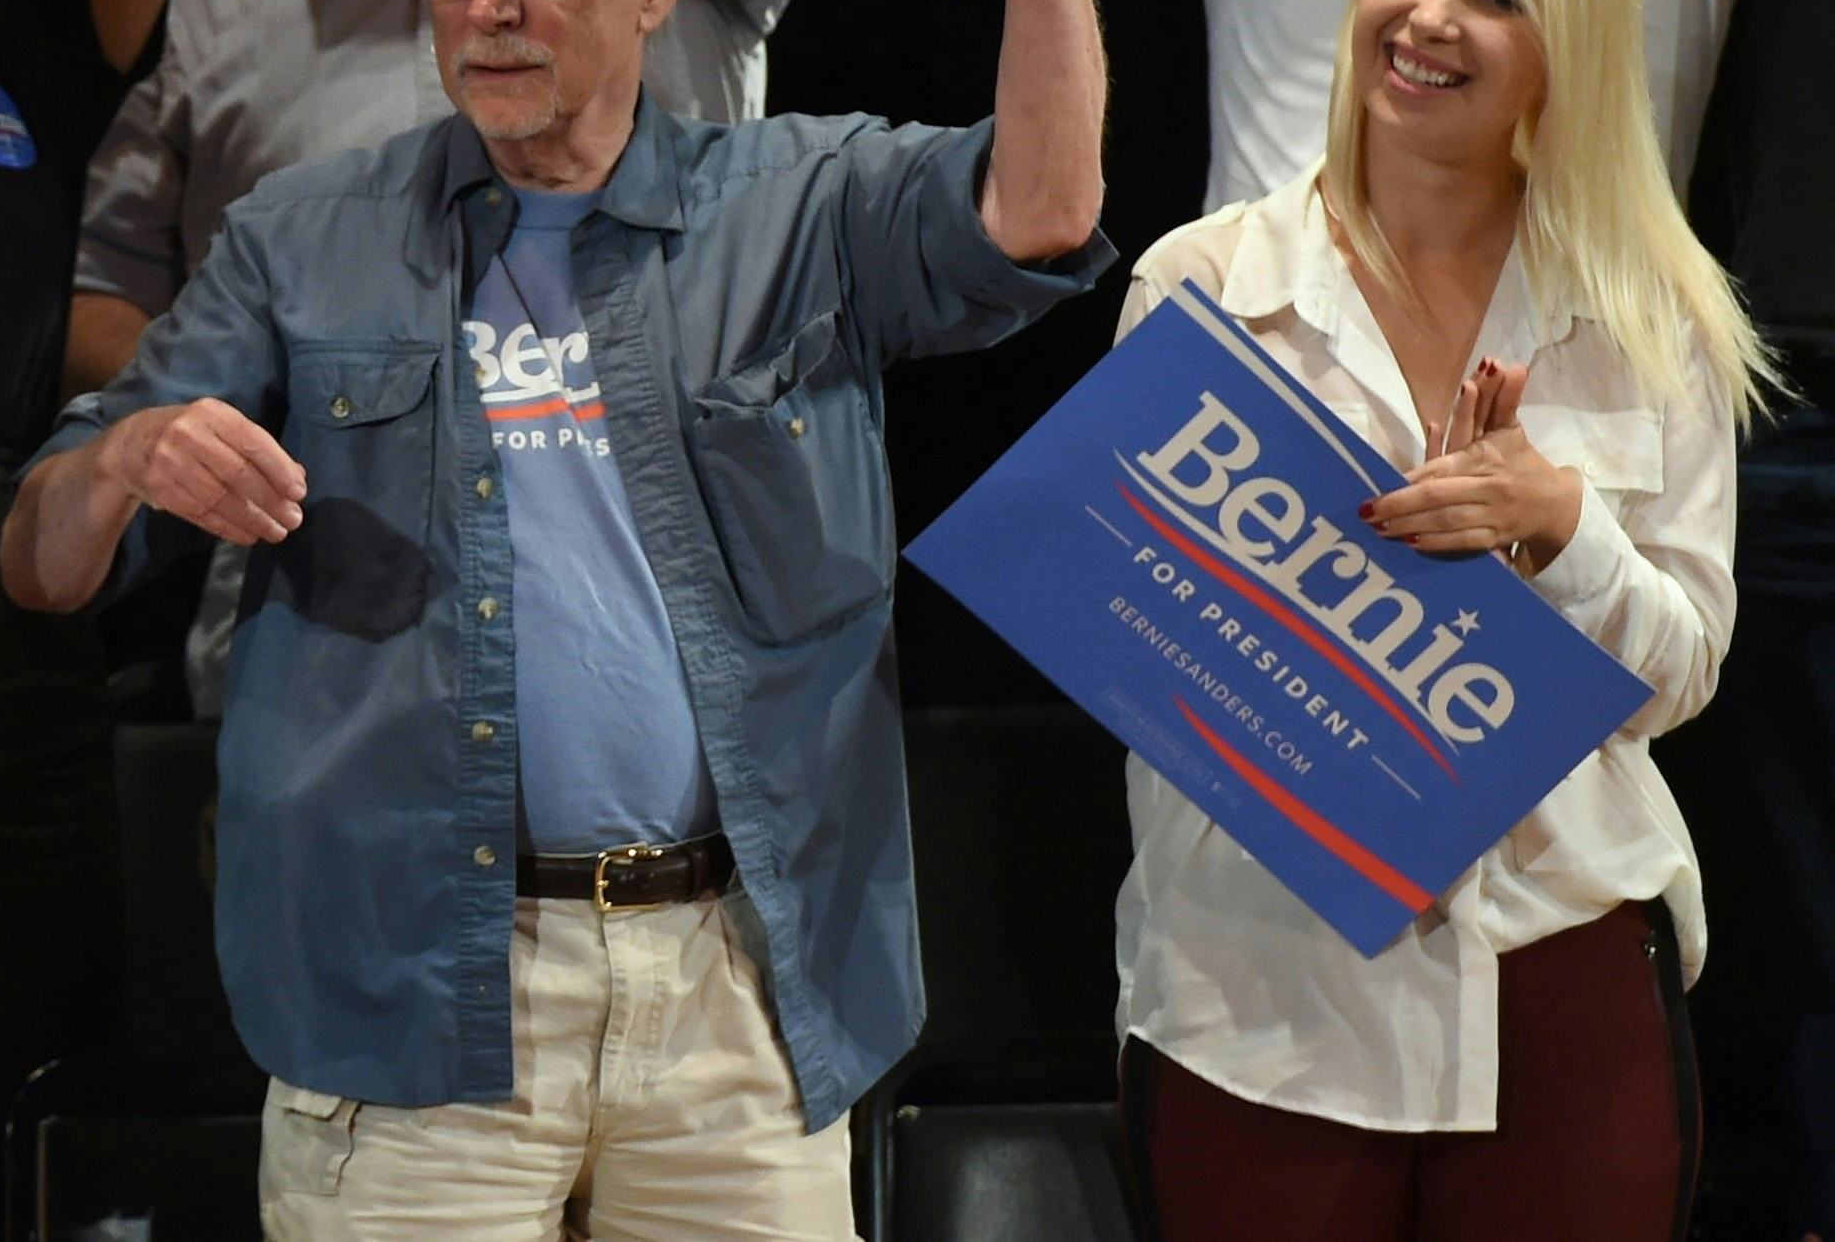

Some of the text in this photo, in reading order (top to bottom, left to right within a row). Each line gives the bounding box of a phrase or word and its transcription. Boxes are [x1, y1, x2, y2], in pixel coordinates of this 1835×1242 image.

[462, 321, 602, 403] Ber
[491, 430, 547, 450] FOR
[1133, 545, 1197, 604] FOR
[1199, 602, 1370, 753] PRESIDENT
[1136, 390, 1515, 744] Bernie
[1107, 595, 1315, 778] BERNIESANDERS.COM
